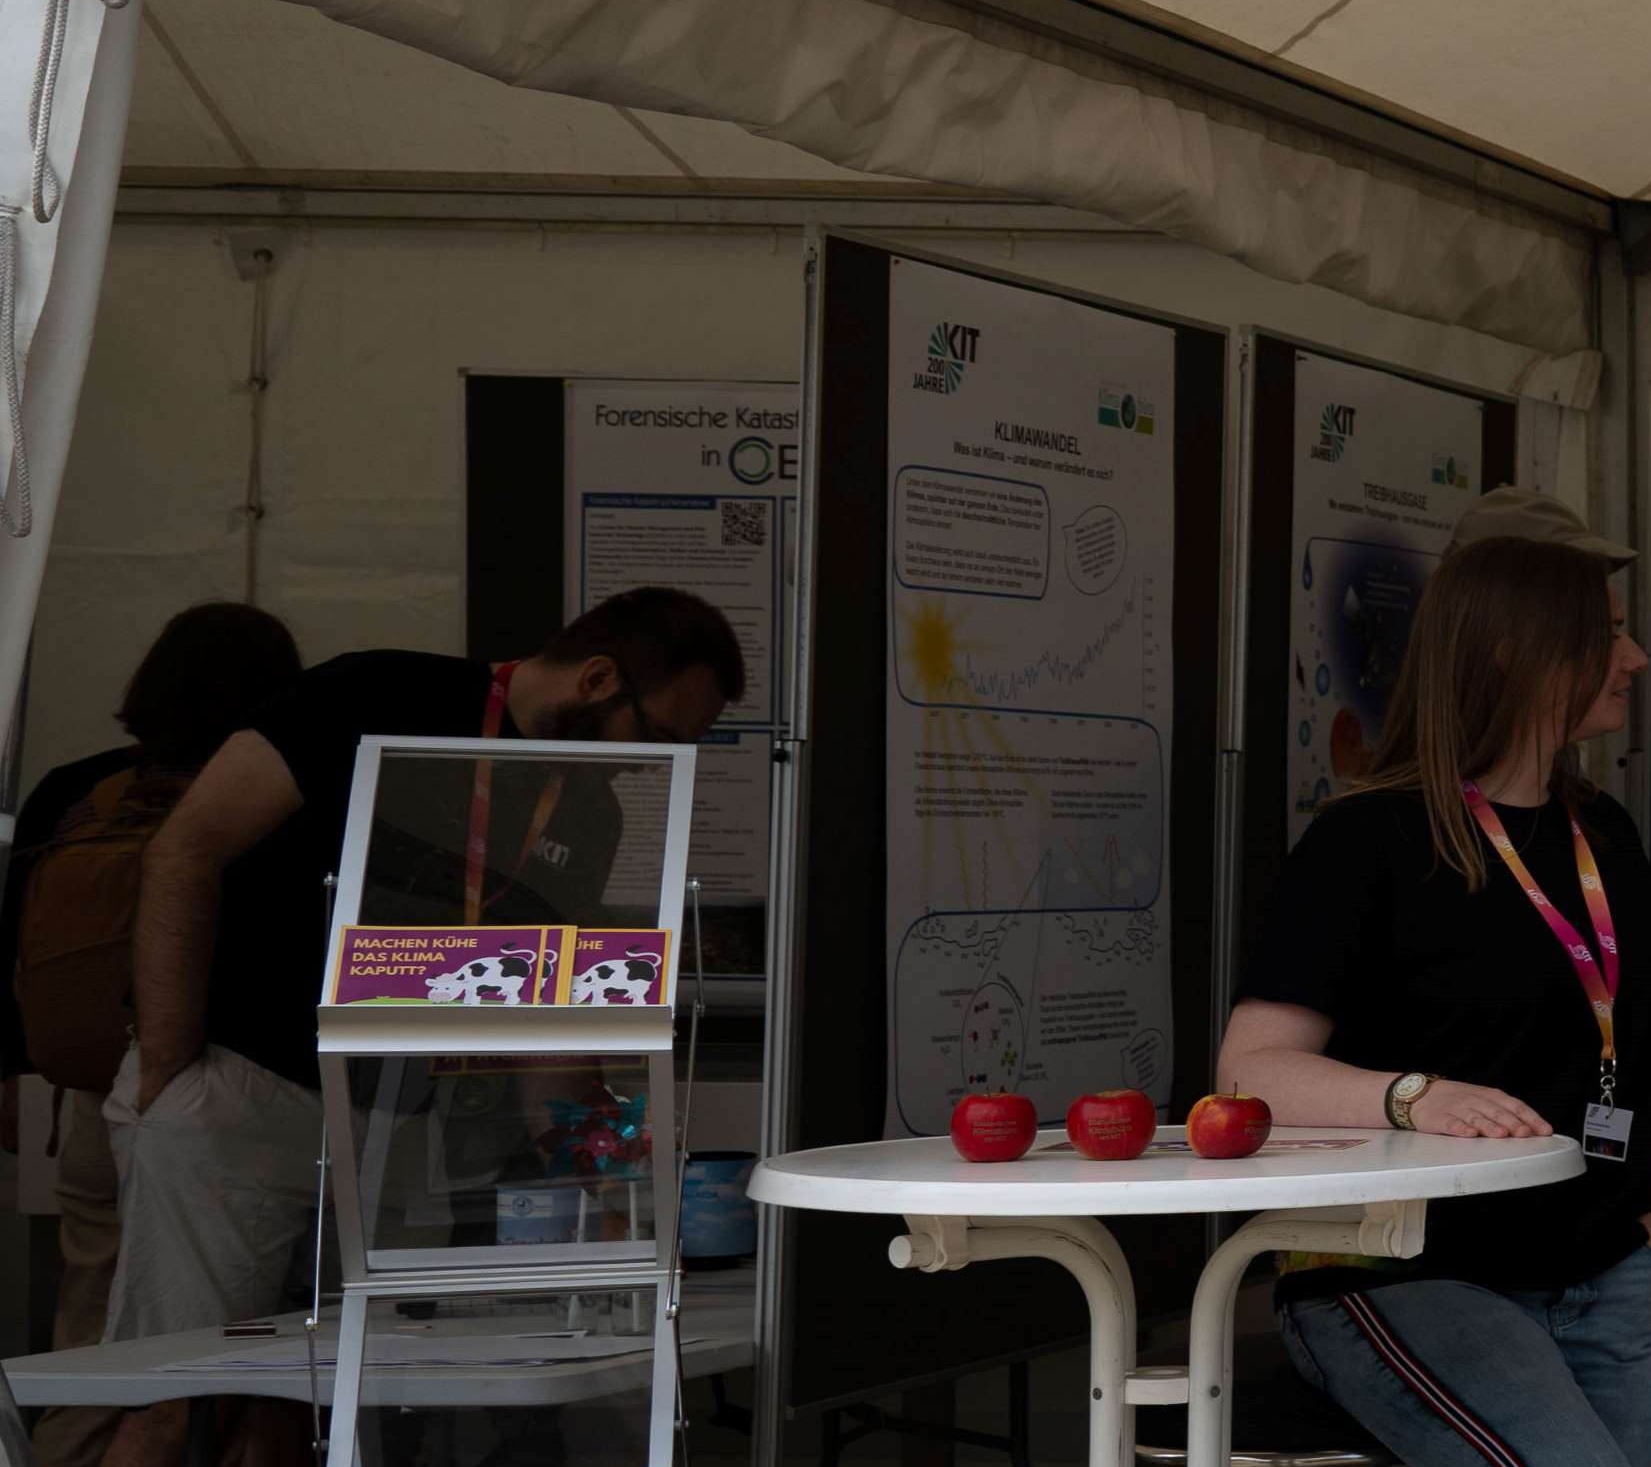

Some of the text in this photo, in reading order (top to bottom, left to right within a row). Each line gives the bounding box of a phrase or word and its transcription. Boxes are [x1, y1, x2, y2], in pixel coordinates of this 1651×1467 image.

[943, 322, 980, 363] KIT
[594, 405, 728, 429] Forensische
[993, 420, 1082, 456] KLIMAWANDEL
[700, 444, 721, 467] in
[353, 935, 478, 949] MACHEN KÜHE
[351, 951, 446, 963] DAS KLIMA
[349, 965, 427, 977] KAPUTT?
